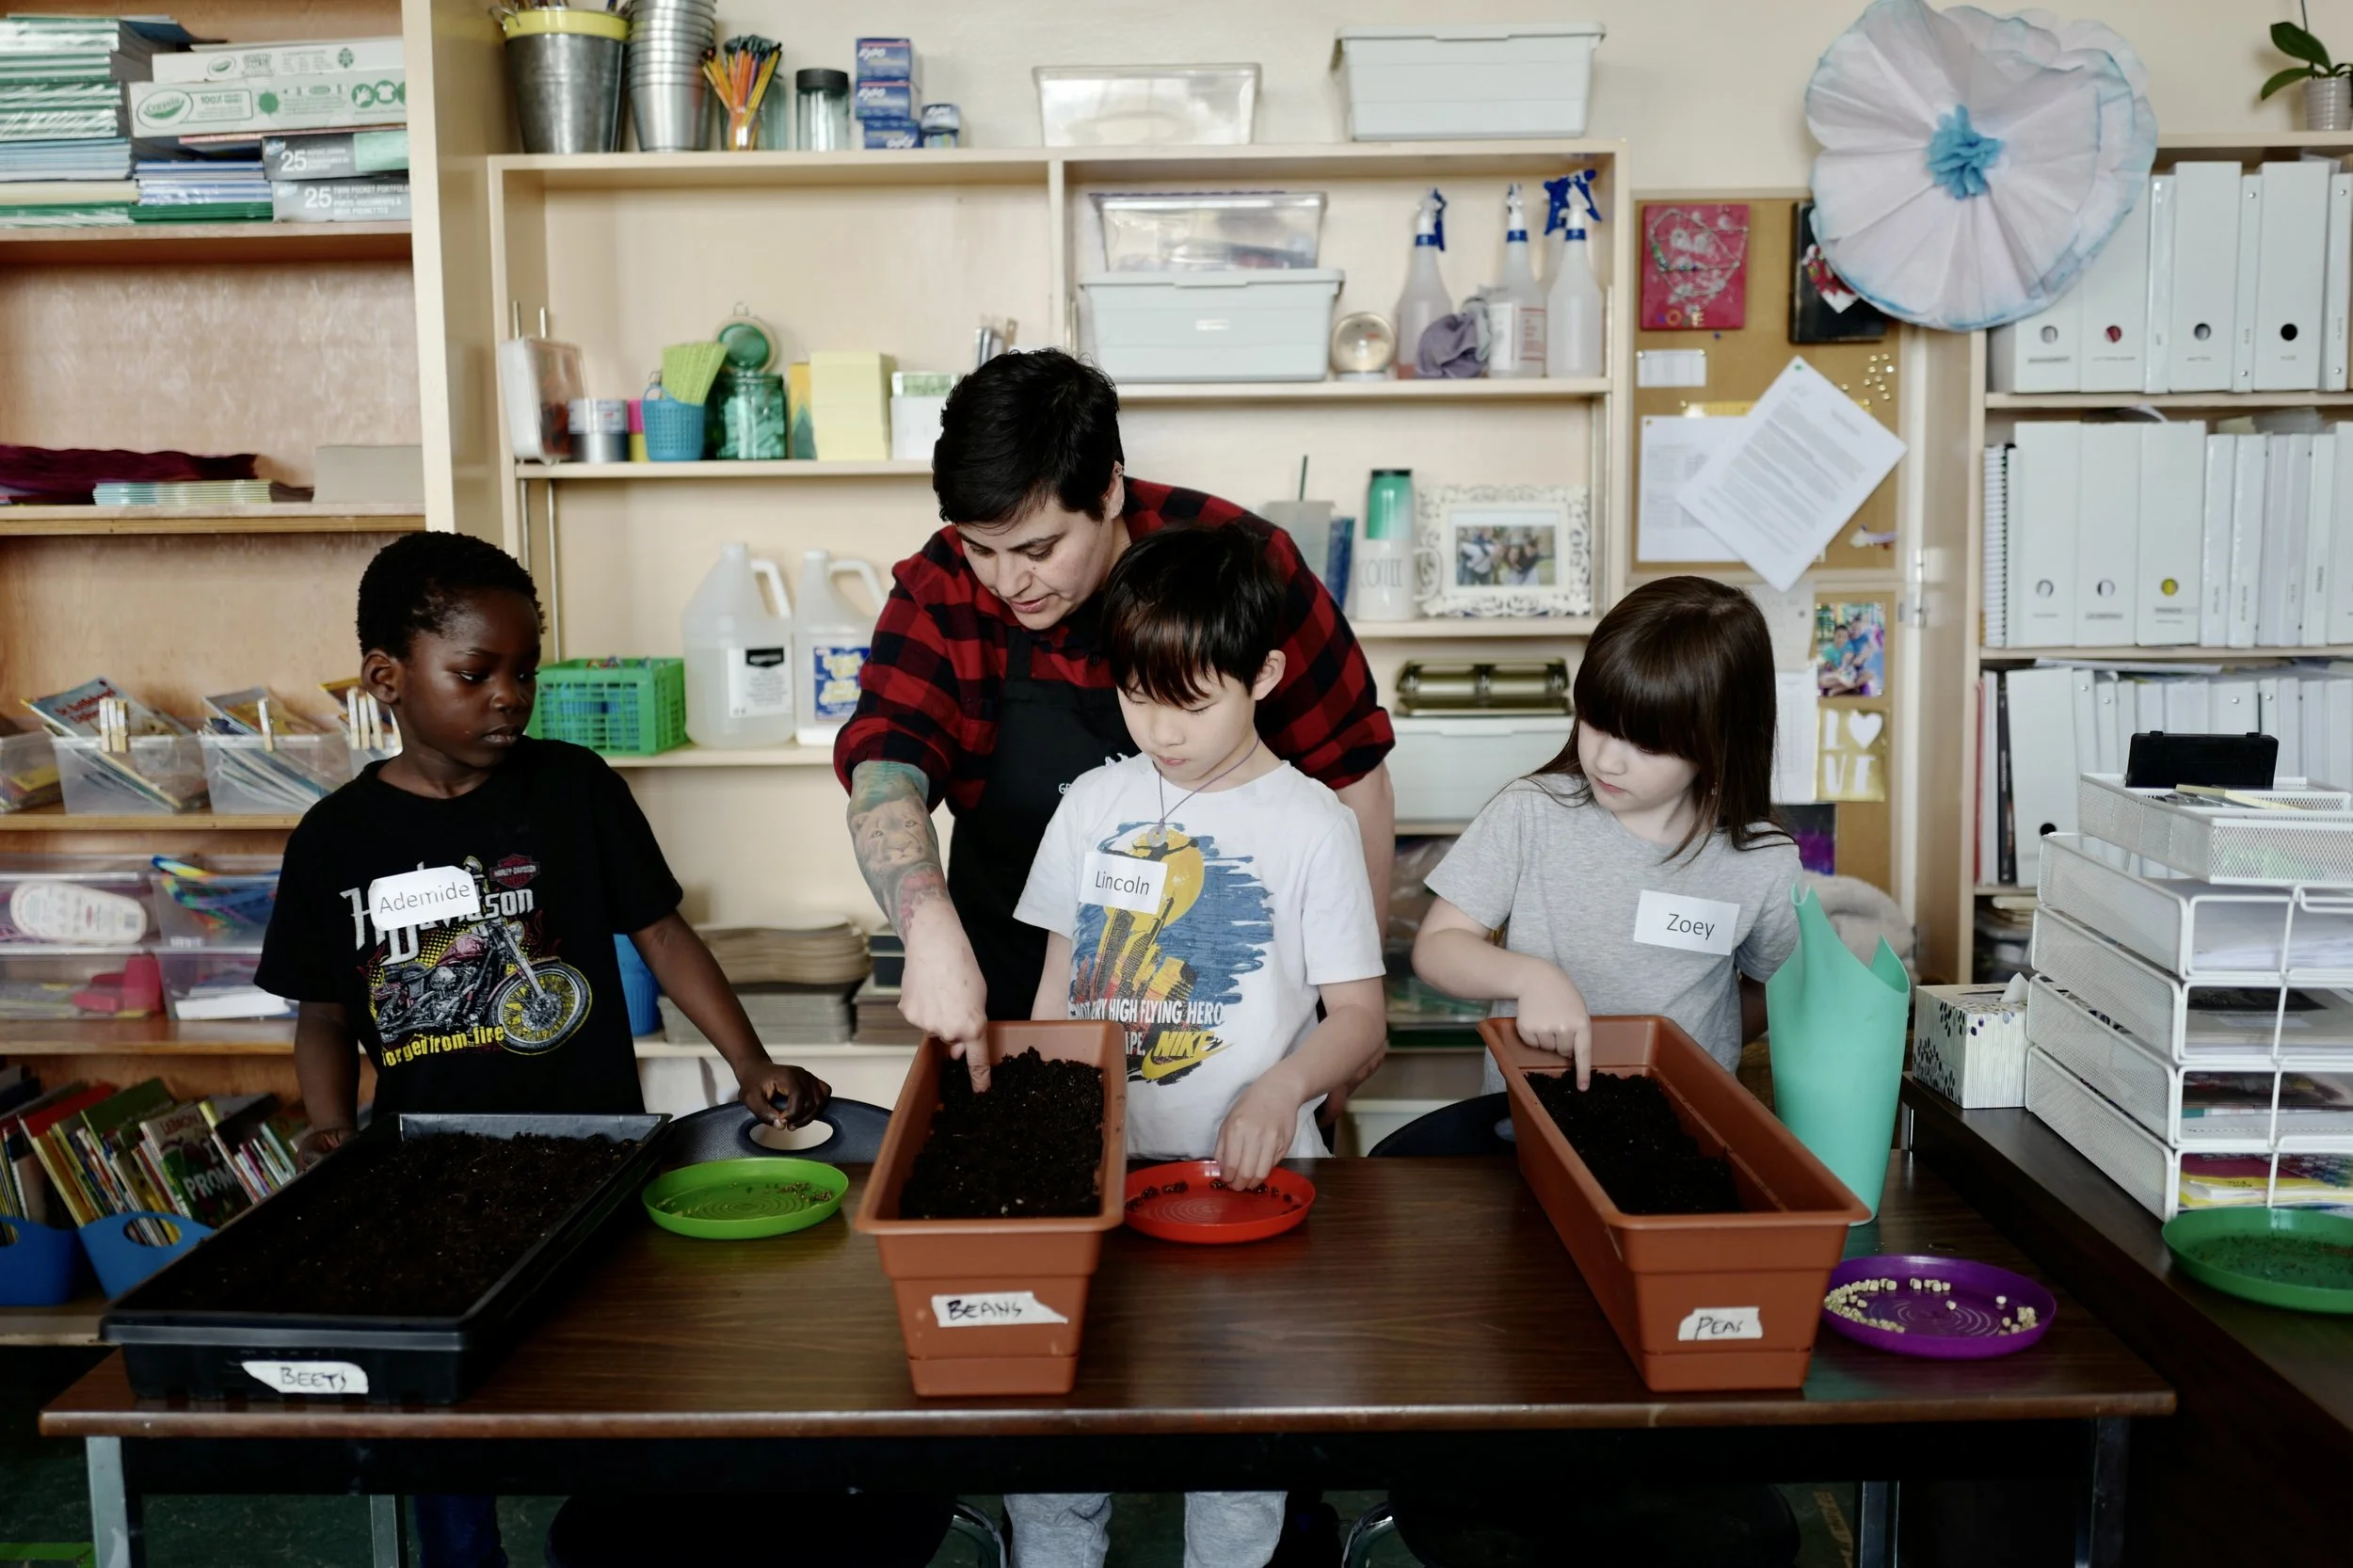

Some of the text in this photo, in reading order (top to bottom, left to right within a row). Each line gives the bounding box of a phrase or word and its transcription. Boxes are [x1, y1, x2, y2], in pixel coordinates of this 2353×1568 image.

[280, 149, 307, 171] 25
[304, 187, 332, 208] 25
[1095, 871, 1149, 895] Lincoln
[379, 881, 471, 914] Ademide
[1667, 913, 1715, 940] Zoey
[1108, 999, 1139, 1022] HIGH
[1140, 1000, 1183, 1023] FLYING
[1186, 1001, 1225, 1024] HERO
[472, 1025, 504, 1045] fire
[1153, 1031, 1215, 1057] NIKE
[947, 1299, 1022, 1320] BEANS
[1695, 1316, 1743, 1341] PEAS
[280, 1367, 346, 1391] BEETS
